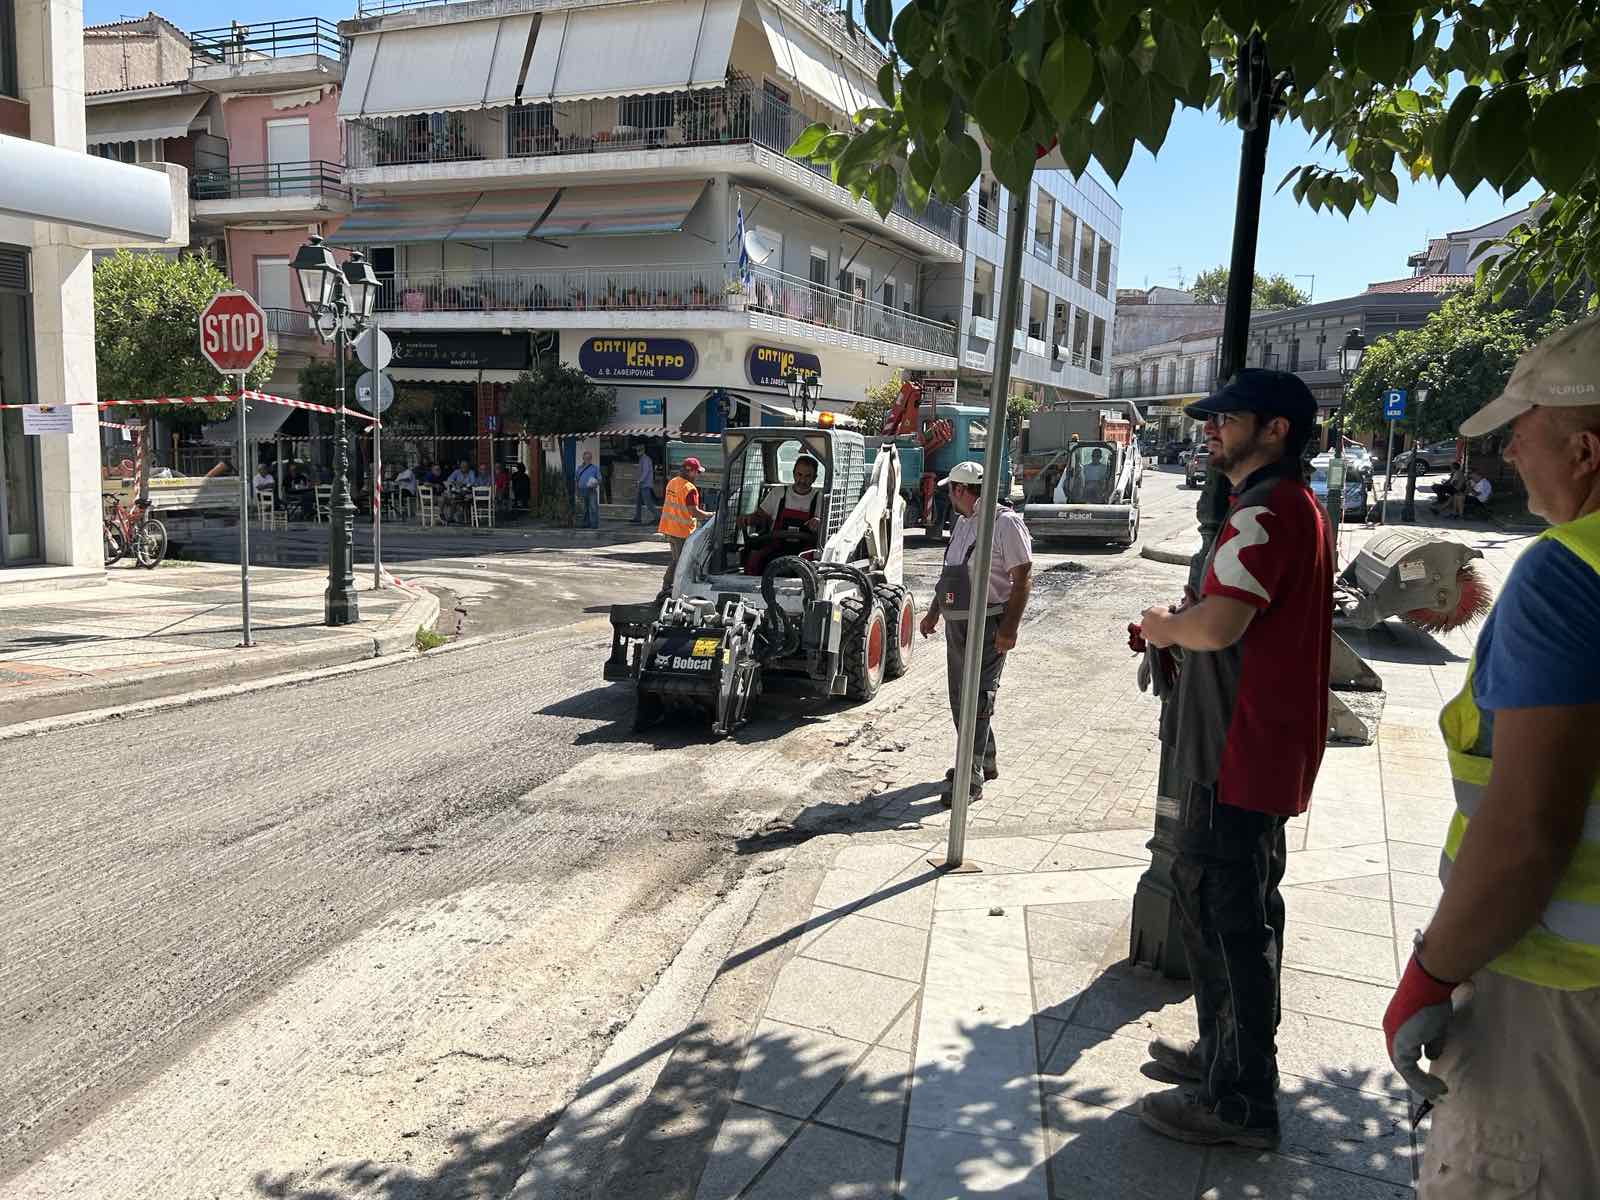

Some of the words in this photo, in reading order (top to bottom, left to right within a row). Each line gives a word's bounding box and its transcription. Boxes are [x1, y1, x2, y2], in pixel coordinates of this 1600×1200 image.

[205, 313, 260, 352] STOP
[593, 340, 647, 358] ΟΠΤΙΚΟ
[626, 350, 684, 367] ΚΕΝΤΡΟ
[613, 368, 655, 377] ΖΑΦΕΙΡΟΥΛΗΣ
[1389, 393, 1400, 407] P
[672, 656, 712, 670] Bobcat
